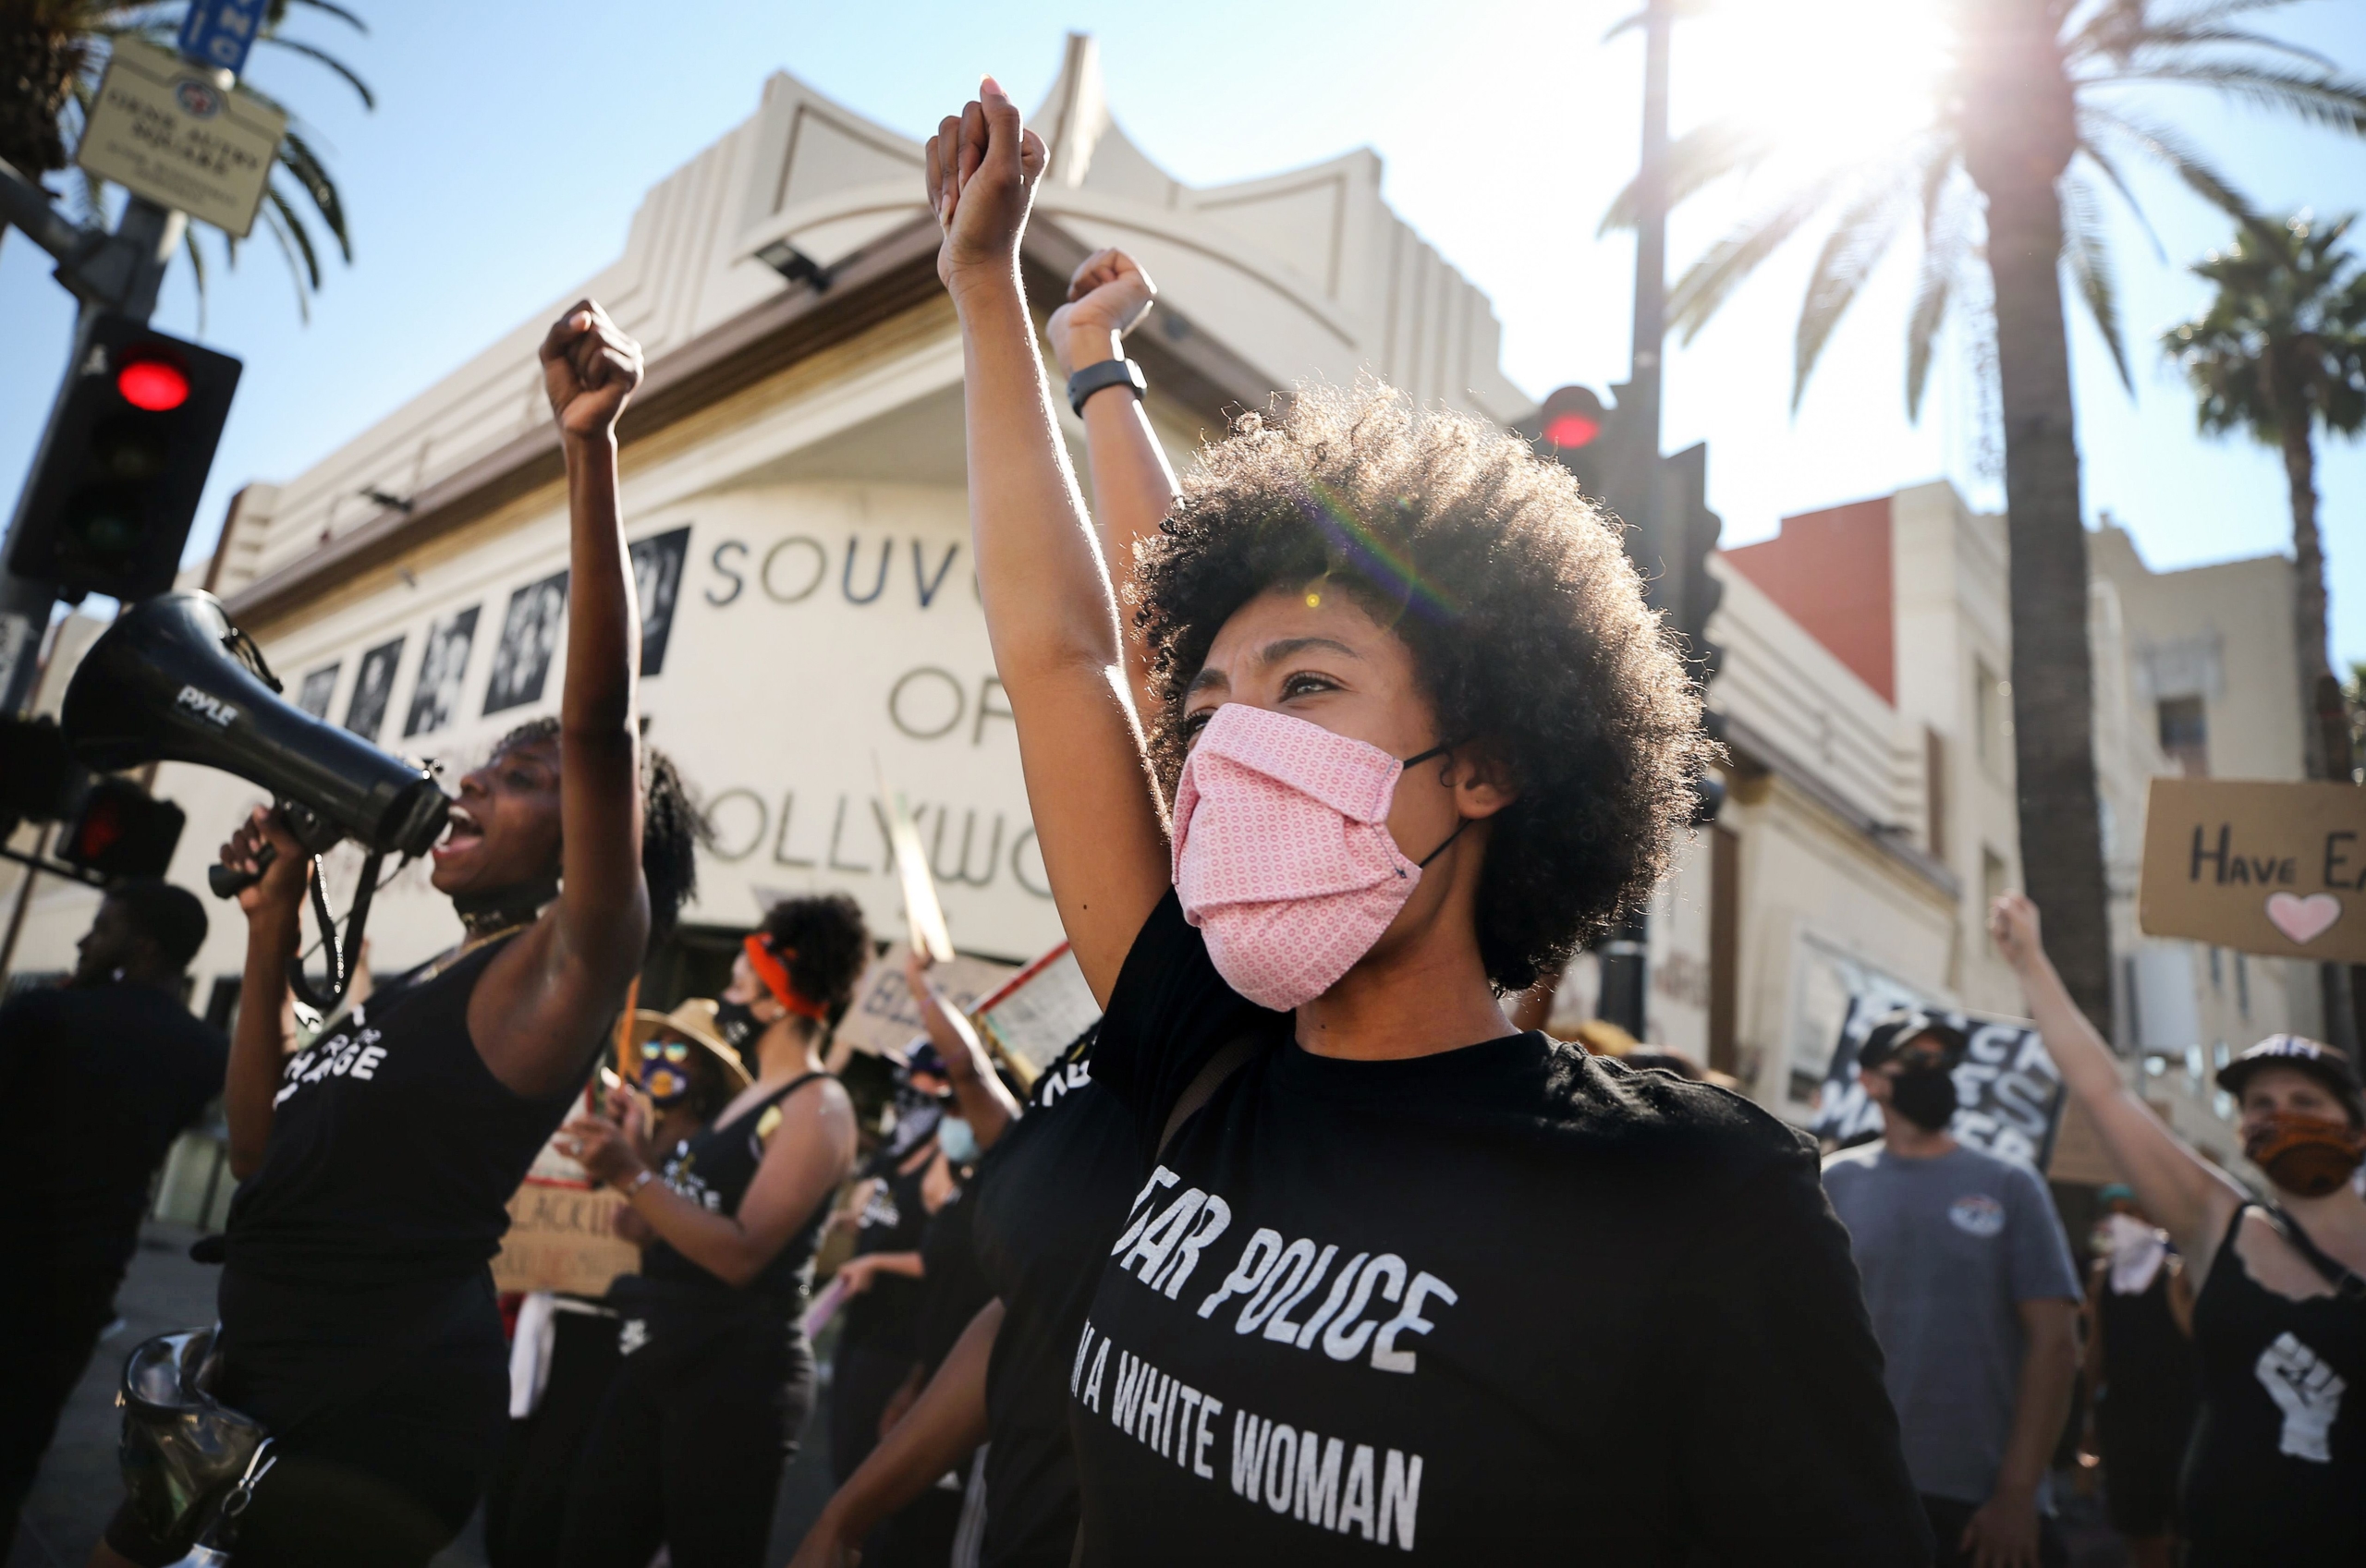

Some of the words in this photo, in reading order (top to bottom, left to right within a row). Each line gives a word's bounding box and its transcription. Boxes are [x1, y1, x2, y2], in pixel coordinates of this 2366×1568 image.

[704, 534, 982, 608] SOUV
[1197, 1227, 1458, 1375] POLICE
[1083, 1336, 1111, 1414] A
[1112, 1350, 1223, 1479] WHITE
[1231, 1409, 1423, 1551] WOMAN
